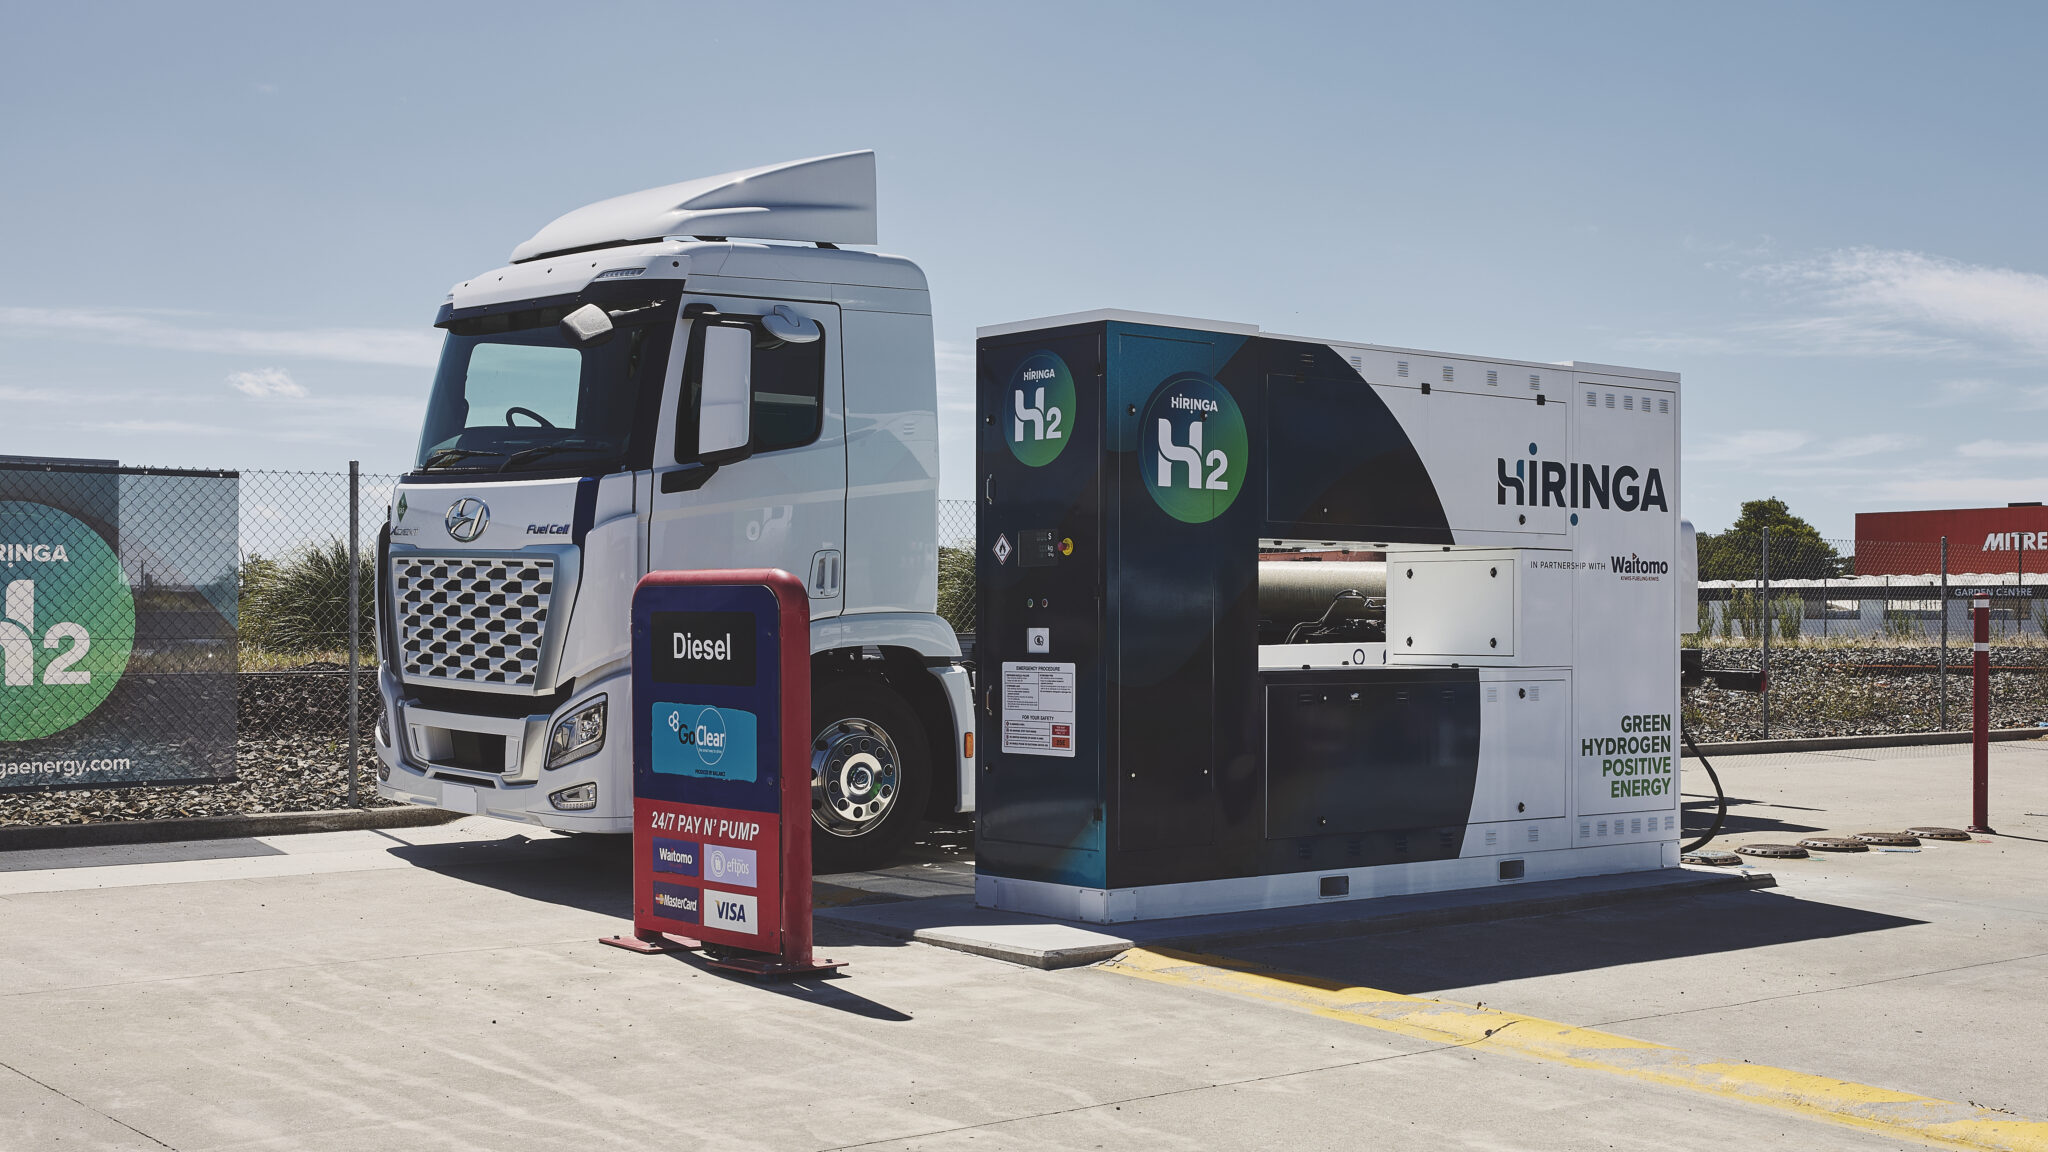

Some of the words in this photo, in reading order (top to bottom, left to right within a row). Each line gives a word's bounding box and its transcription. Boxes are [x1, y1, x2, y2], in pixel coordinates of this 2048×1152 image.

[1023, 368, 1056, 383] HIRINGA
[1171, 393, 1218, 414] HIRINGA
[1014, 387, 1063, 442] H2
[1157, 418, 1229, 490] H2
[1497, 442, 1668, 526] HIRINGA
[526, 524, 549, 535] Fuel
[549, 523, 571, 535] Cell
[1982, 531, 2048, 552] MITRE
[1530, 561, 1538, 569] IN
[1540, 561, 1586, 570] PARTNERSHIP
[1588, 562, 1606, 570] WITH
[1611, 552, 1669, 575] Waitomo
[1954, 588, 1994, 598] GARDEN
[1995, 587, 2033, 597] CENTRE
[673, 632, 731, 661] Diesel
[1621, 714, 1671, 733] GREEN
[1582, 735, 1671, 757] HYDROGEN
[1602, 756, 1671, 777] POSITIVE
[1611, 777, 1671, 799] ENERGY
[651, 811, 676, 830] 24/7
[677, 814, 702, 834] PAY
[719, 820, 760, 841] PUMP
[659, 847, 693, 865] Waitomo
[726, 857, 749, 877] eftpos
[663, 894, 698, 912] MasterCard
[715, 900, 746, 923] VISA
